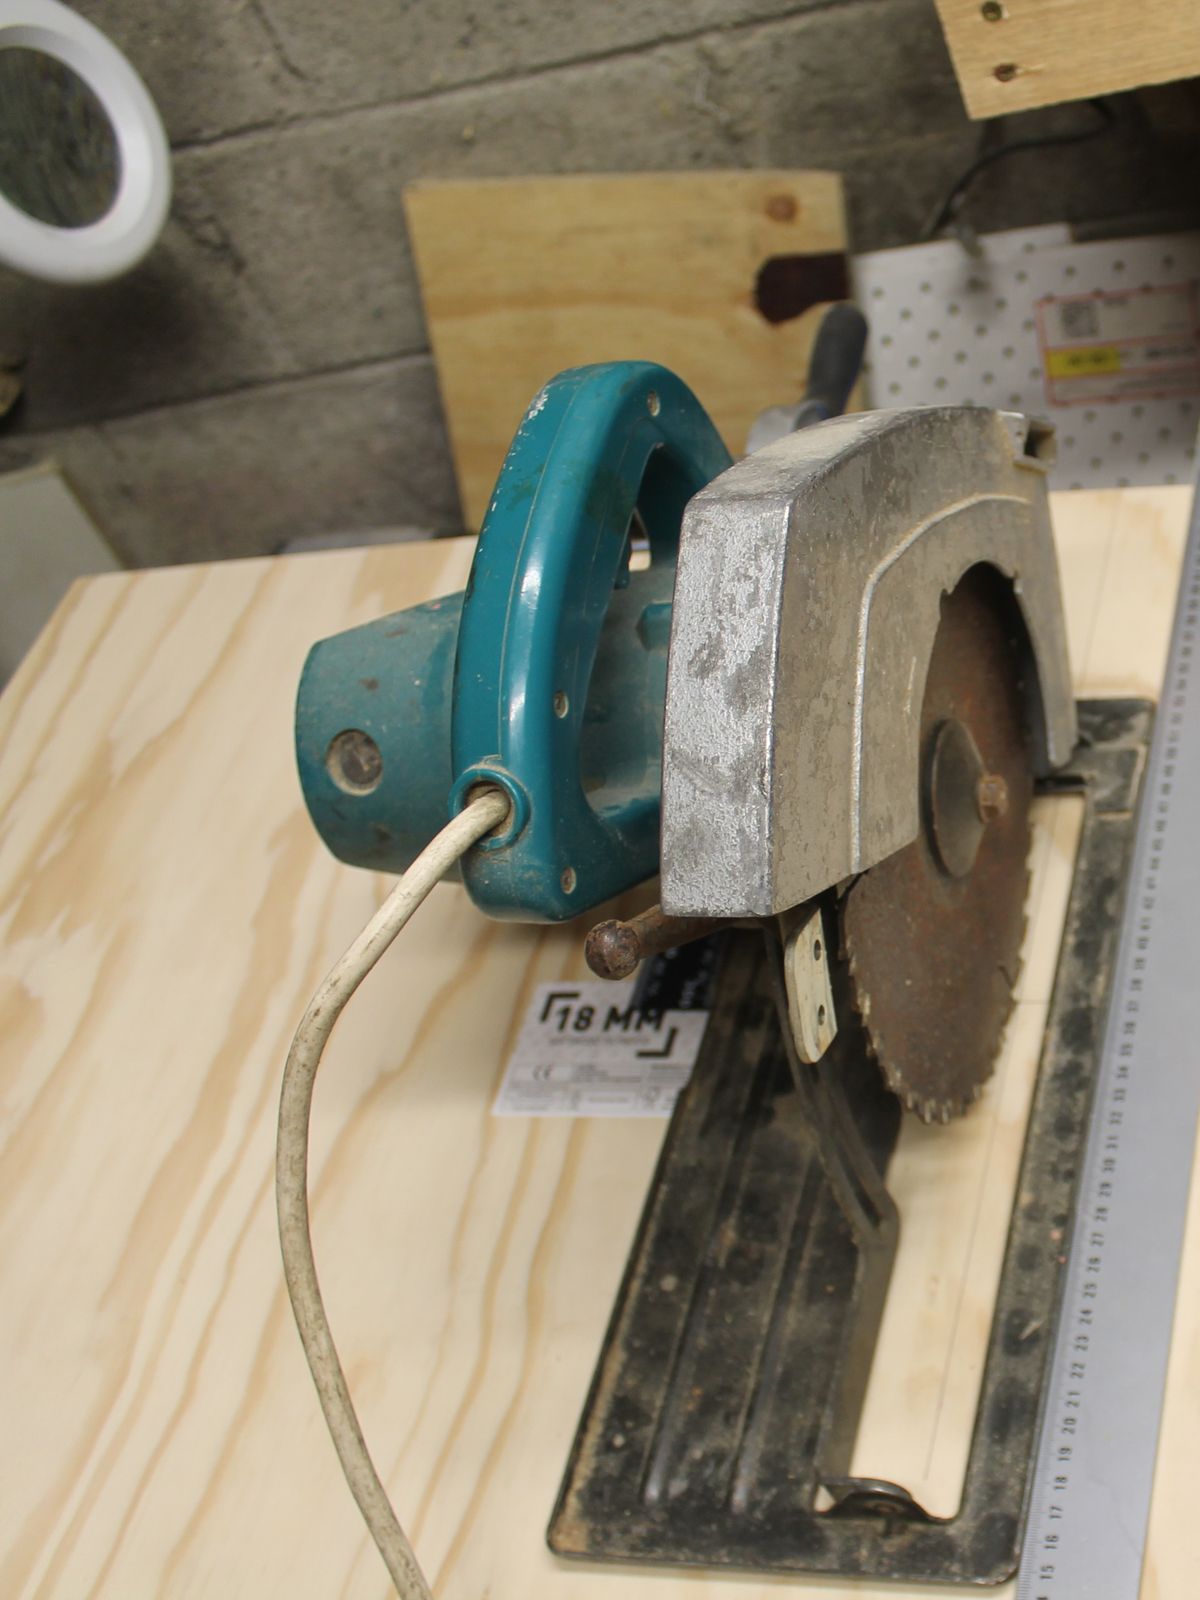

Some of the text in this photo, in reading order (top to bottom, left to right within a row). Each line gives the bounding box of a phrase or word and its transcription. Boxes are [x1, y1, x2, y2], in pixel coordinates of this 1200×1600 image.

[557, 1004, 664, 1032] 18 MM
[1090, 1232, 1104, 1248] 27
[1086, 1257, 1101, 1273] 26
[1082, 1283, 1097, 1299] 25
[1074, 1336, 1089, 1352] 23
[1069, 1363, 1086, 1380] 22
[1064, 1391, 1080, 1409] 21
[1061, 1417, 1077, 1435] 20
[1057, 1447, 1072, 1462] 19
[1053, 1476, 1068, 1491] 18
[1048, 1506, 1063, 1520] 17
[1044, 1535, 1059, 1550] 16
[1039, 1566, 1055, 1581] 15
